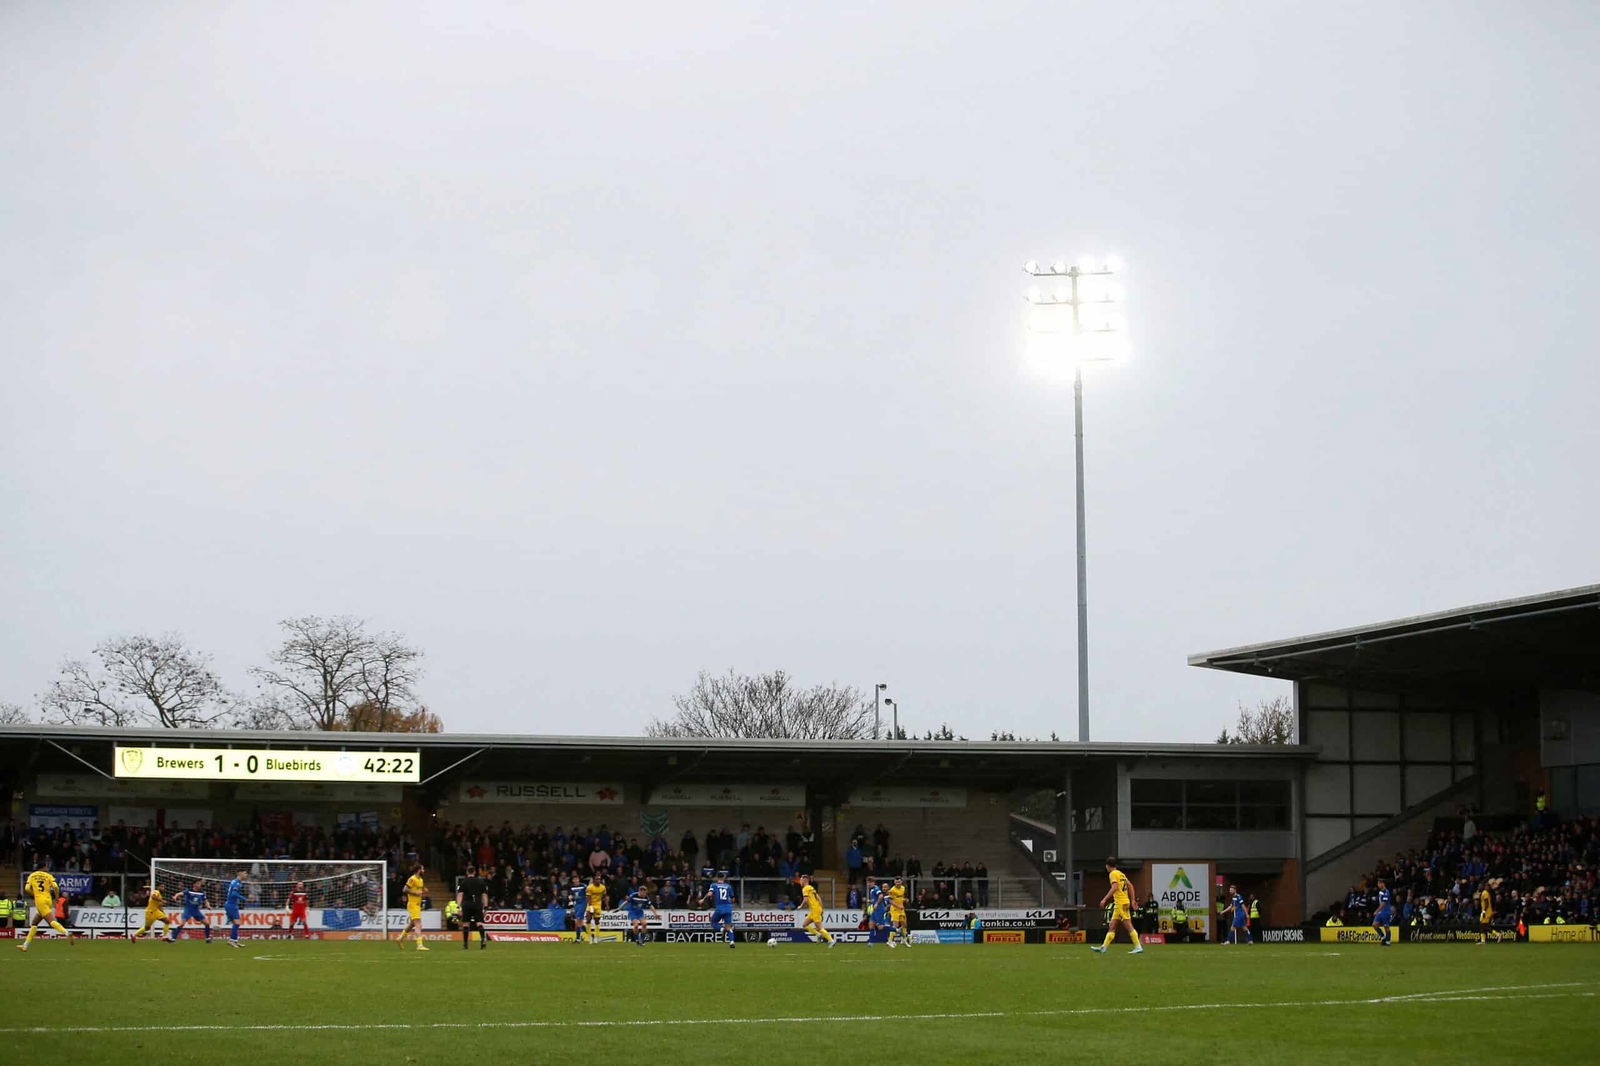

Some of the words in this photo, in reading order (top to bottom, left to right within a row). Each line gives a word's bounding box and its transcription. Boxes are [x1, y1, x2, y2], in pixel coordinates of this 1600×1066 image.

[157, 757, 205, 769] Brewers
[214, 755, 224, 773] 1
[247, 755, 259, 775] 0
[266, 758, 322, 771] Bluebirds
[364, 758, 414, 773] 42:22
[496, 785, 586, 798] RUSSELL
[37, 881, 45, 893] 3
[59, 878, 90, 887] ARMY
[719, 888, 728, 901] 12
[1161, 891, 1201, 902] ABODE
[81, 912, 139, 924] PRESTEC
[668, 913, 687, 923] Ian
[745, 912, 795, 922] Butchers
[922, 911, 950, 919] KIA
[1025, 910, 1053, 918] KIA
[1262, 930, 1284, 942] HARDY
[1284, 929, 1304, 941] SIGNS
[1551, 927, 1577, 941] Home
[1580, 926, 1588, 941] of
